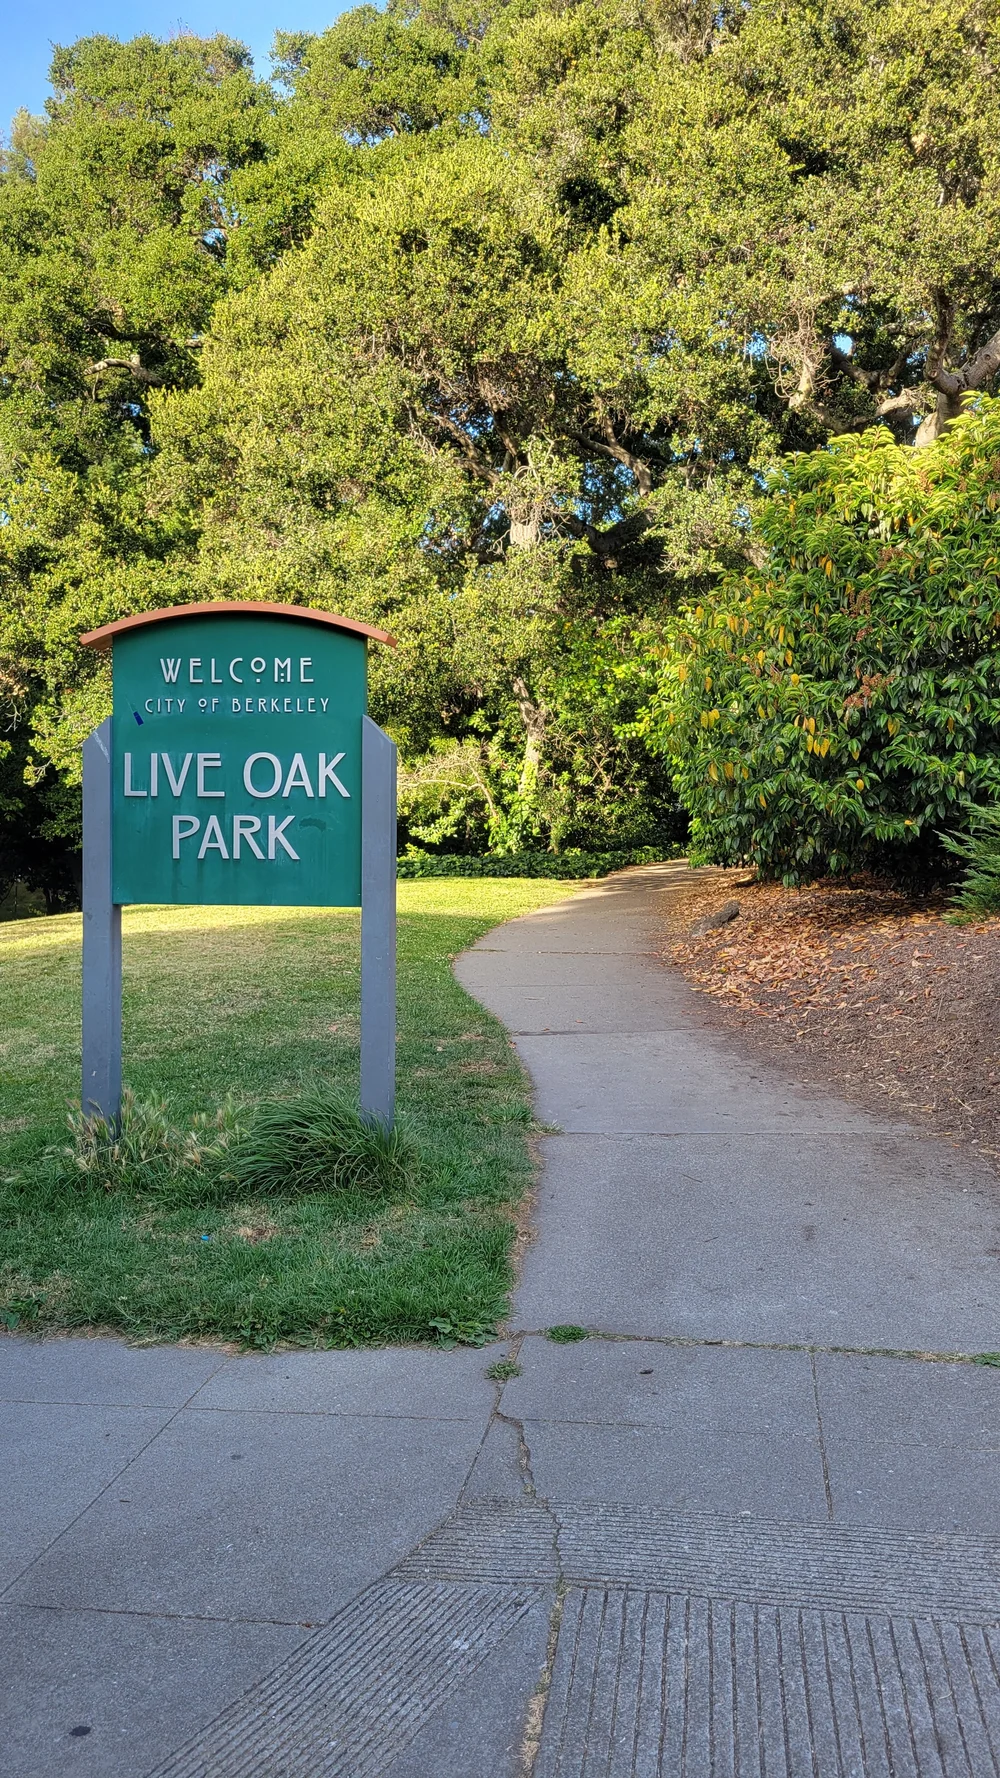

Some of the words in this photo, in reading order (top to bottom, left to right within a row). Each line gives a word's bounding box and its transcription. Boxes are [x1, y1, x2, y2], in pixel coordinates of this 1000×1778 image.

[159, 657, 314, 683] WELCOME
[144, 698, 186, 713] CITY
[197, 698, 219, 713] OF
[232, 697, 329, 712] BERKELEY
[123, 752, 225, 797] LIVE
[243, 751, 350, 798] OAK
[172, 814, 300, 860] PARK
